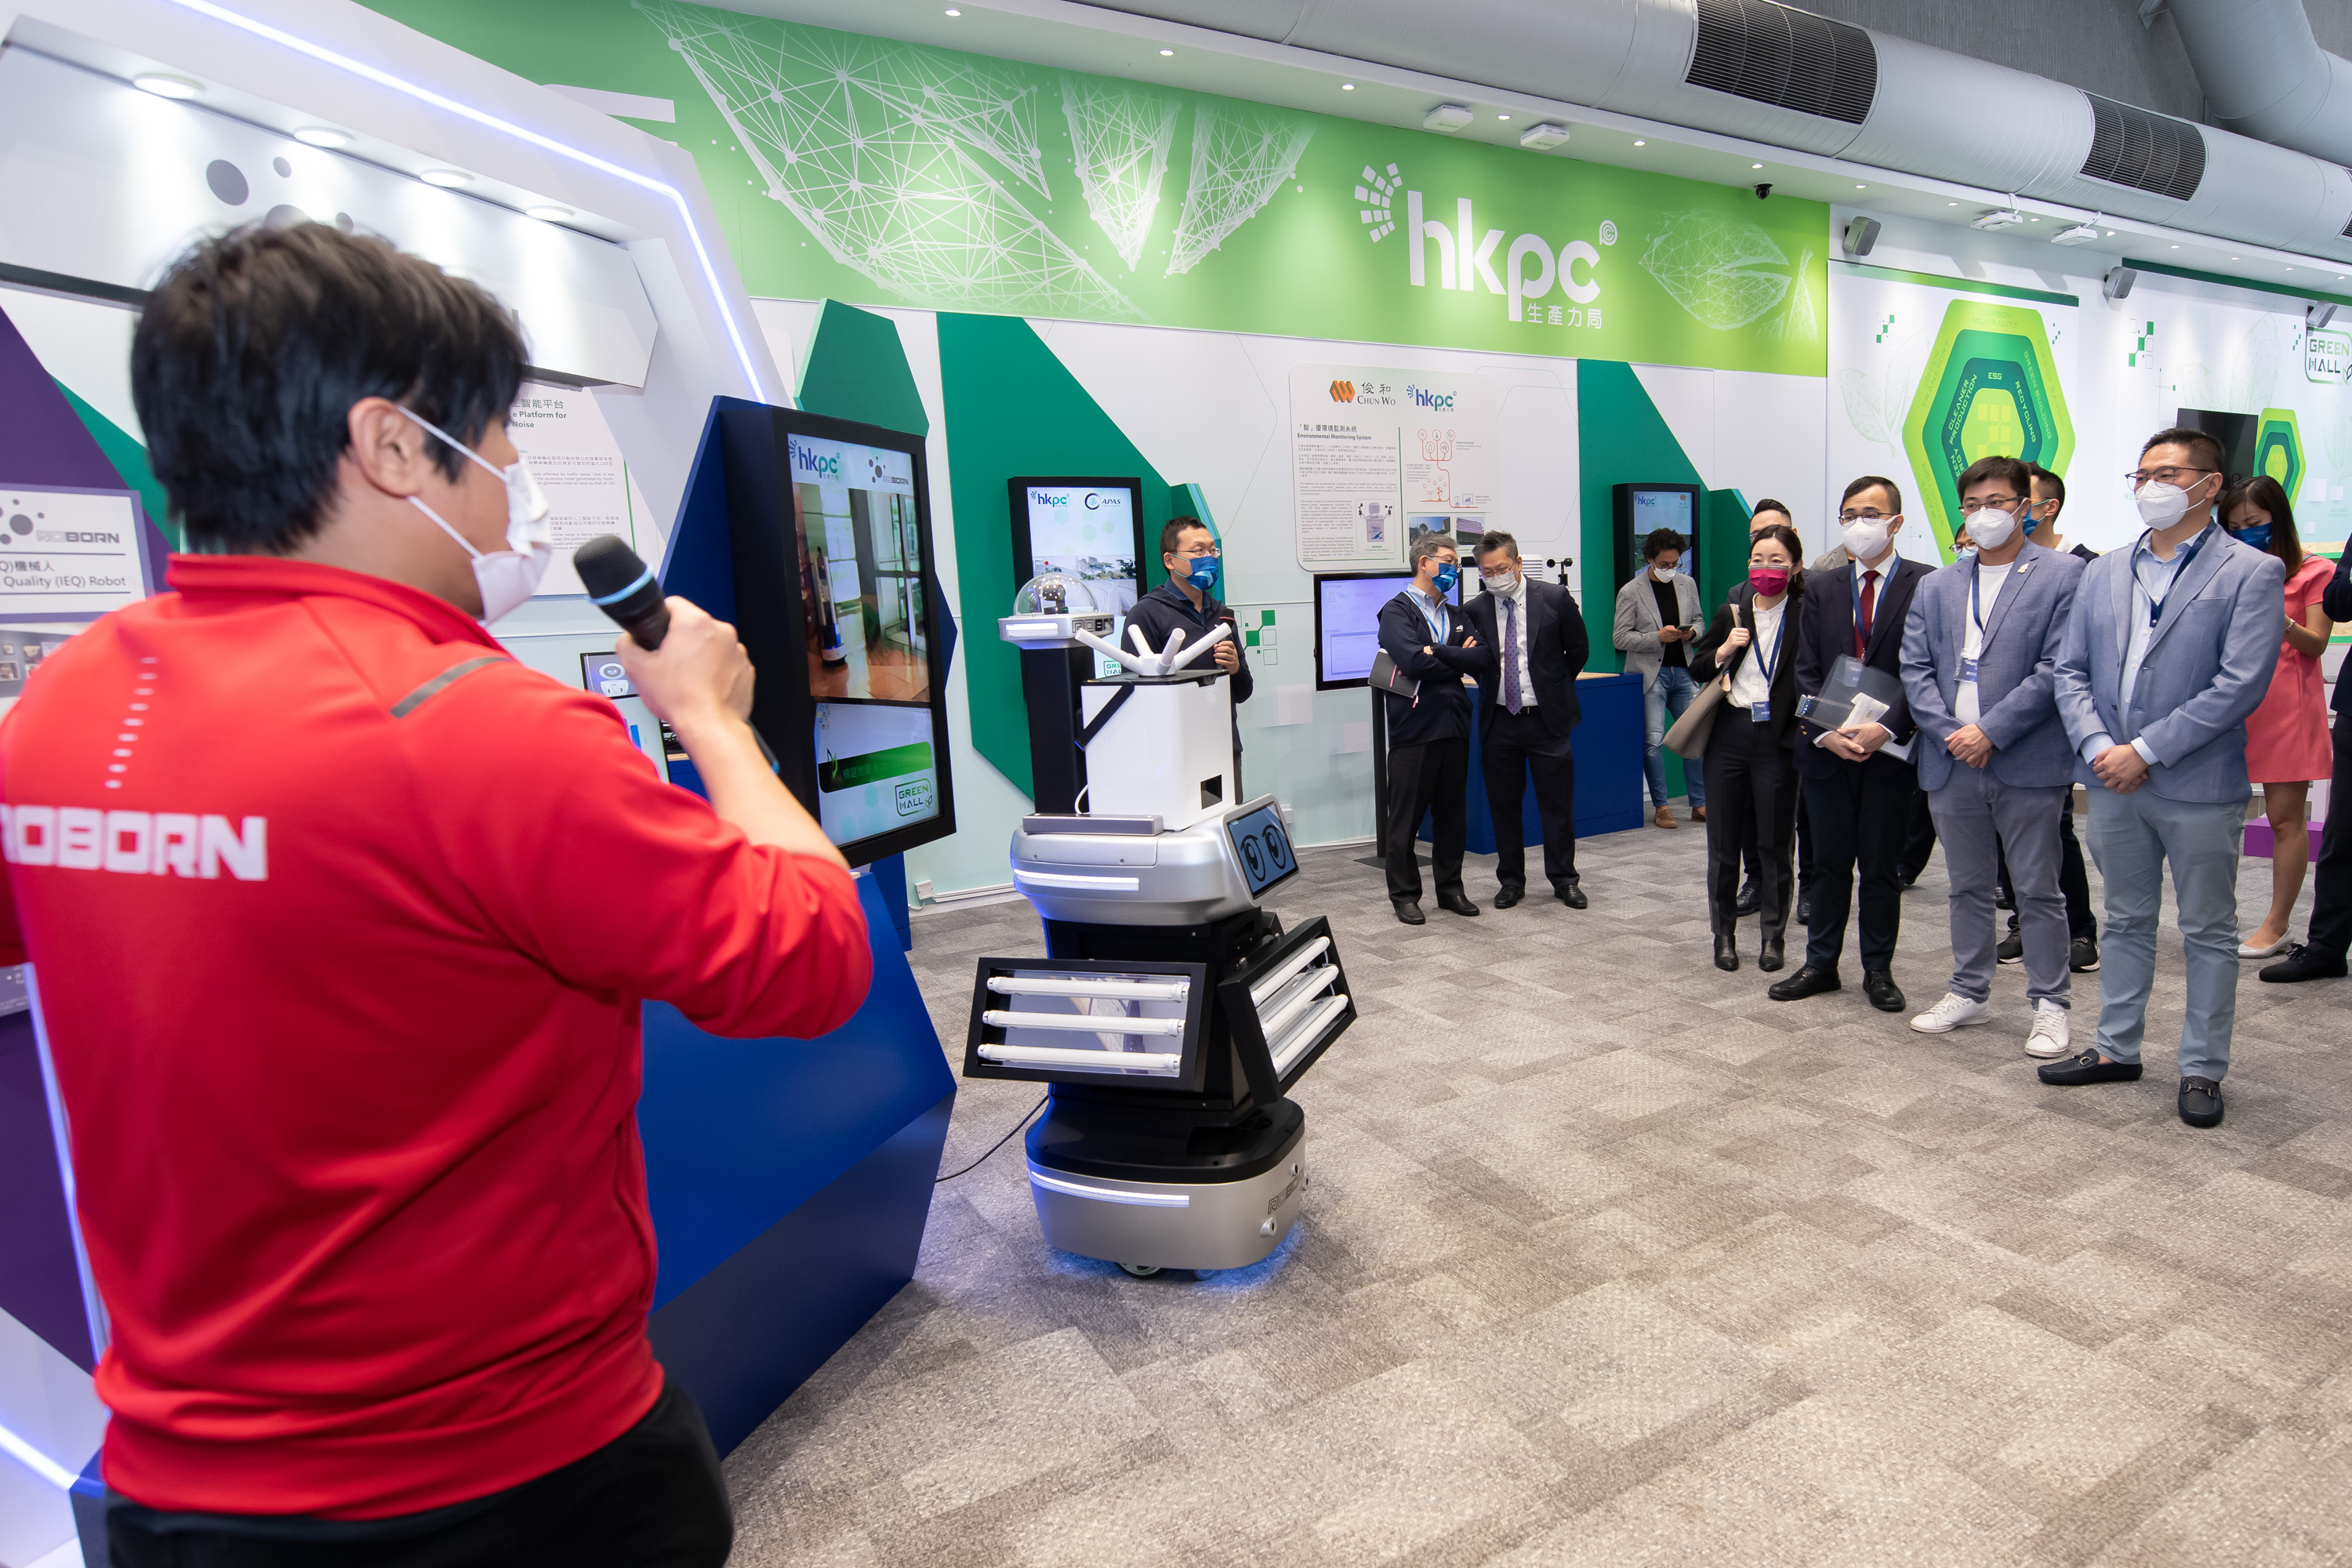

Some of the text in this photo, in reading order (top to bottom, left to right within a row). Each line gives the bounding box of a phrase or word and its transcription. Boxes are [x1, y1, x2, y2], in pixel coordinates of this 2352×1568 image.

[1407, 190, 1601, 322] hkpc
[1527, 303, 1602, 329] 生產力局
[1980, 308, 2012, 319] CARBON
[1971, 318, 2019, 328] NEUTRALITY
[2309, 339, 2350, 357] GREEN
[1922, 339, 1950, 408] TRANSPORT
[2308, 357, 2341, 374] HALL
[1987, 372, 2002, 380] ESG
[1361, 382, 1391, 395] 俊和
[2024, 350, 2053, 440] GREEN BUILDING
[1415, 388, 1454, 412] hkpc
[1947, 379, 1969, 431] CLEANER
[519, 410, 554, 419] Platform
[1949, 373, 1978, 445] PRODUCTION
[2015, 380, 2037, 443] RECYCLING
[798, 445, 838, 478] hkpc
[883, 475, 909, 485] ROBORN
[1037, 493, 1067, 507] hkpc
[1637, 495, 1655, 507] hkpc
[37, 530, 120, 543] ROBORN
[3, 575, 126, 588] Quality (IEQ) Robot
[898, 784, 928, 800] GREEN
[899, 797, 924, 811] HALL
